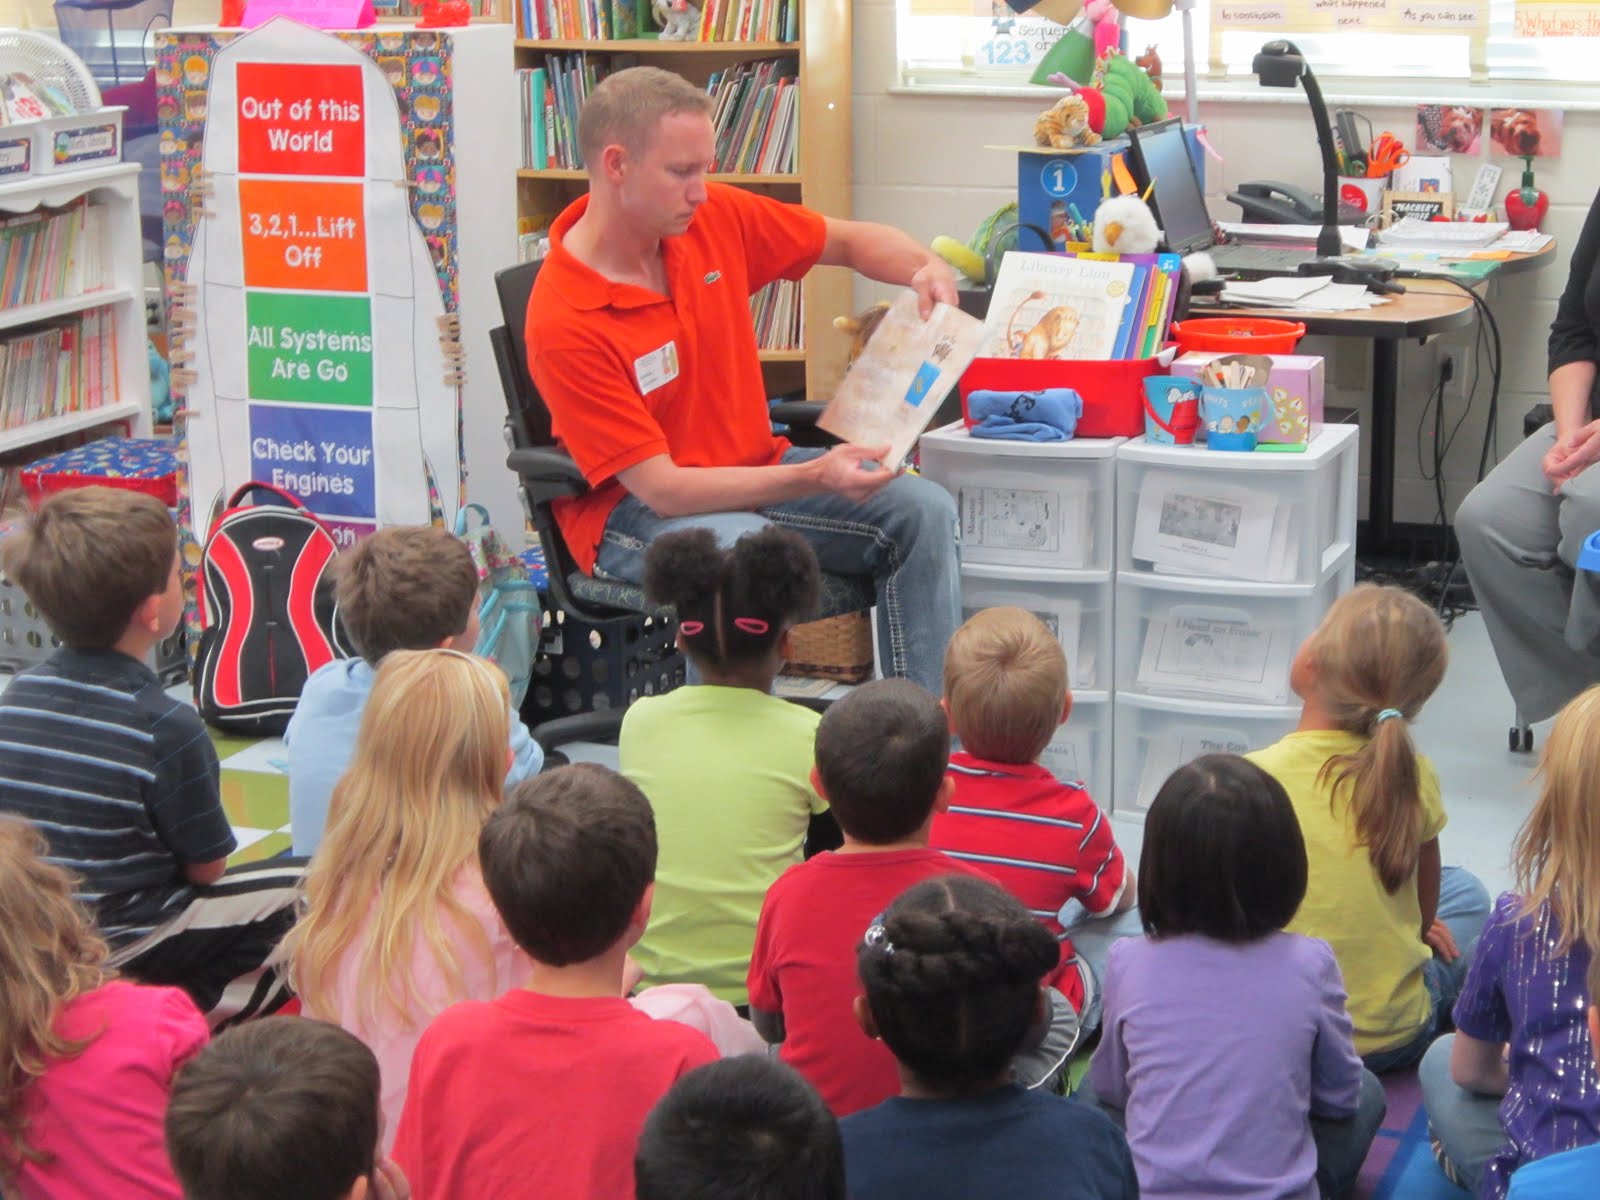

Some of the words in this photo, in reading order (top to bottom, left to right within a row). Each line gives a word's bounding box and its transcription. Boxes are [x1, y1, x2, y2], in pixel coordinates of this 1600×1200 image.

[982, 39, 1031, 64] 123
[241, 96, 283, 120] Out
[289, 98, 312, 121] of
[318, 99, 361, 122] this
[268, 129, 333, 153] World
[285, 245, 322, 269] Off
[1020, 258, 1073, 278] Library
[1079, 265, 1112, 281] Lion
[248, 325, 274, 349] All
[280, 327, 372, 354] Systems
[271, 358, 311, 380] Are
[317, 359, 349, 383] Go
[252, 437, 316, 462] Check
[320, 442, 371, 466] Your
[271, 468, 354, 496] Engines
